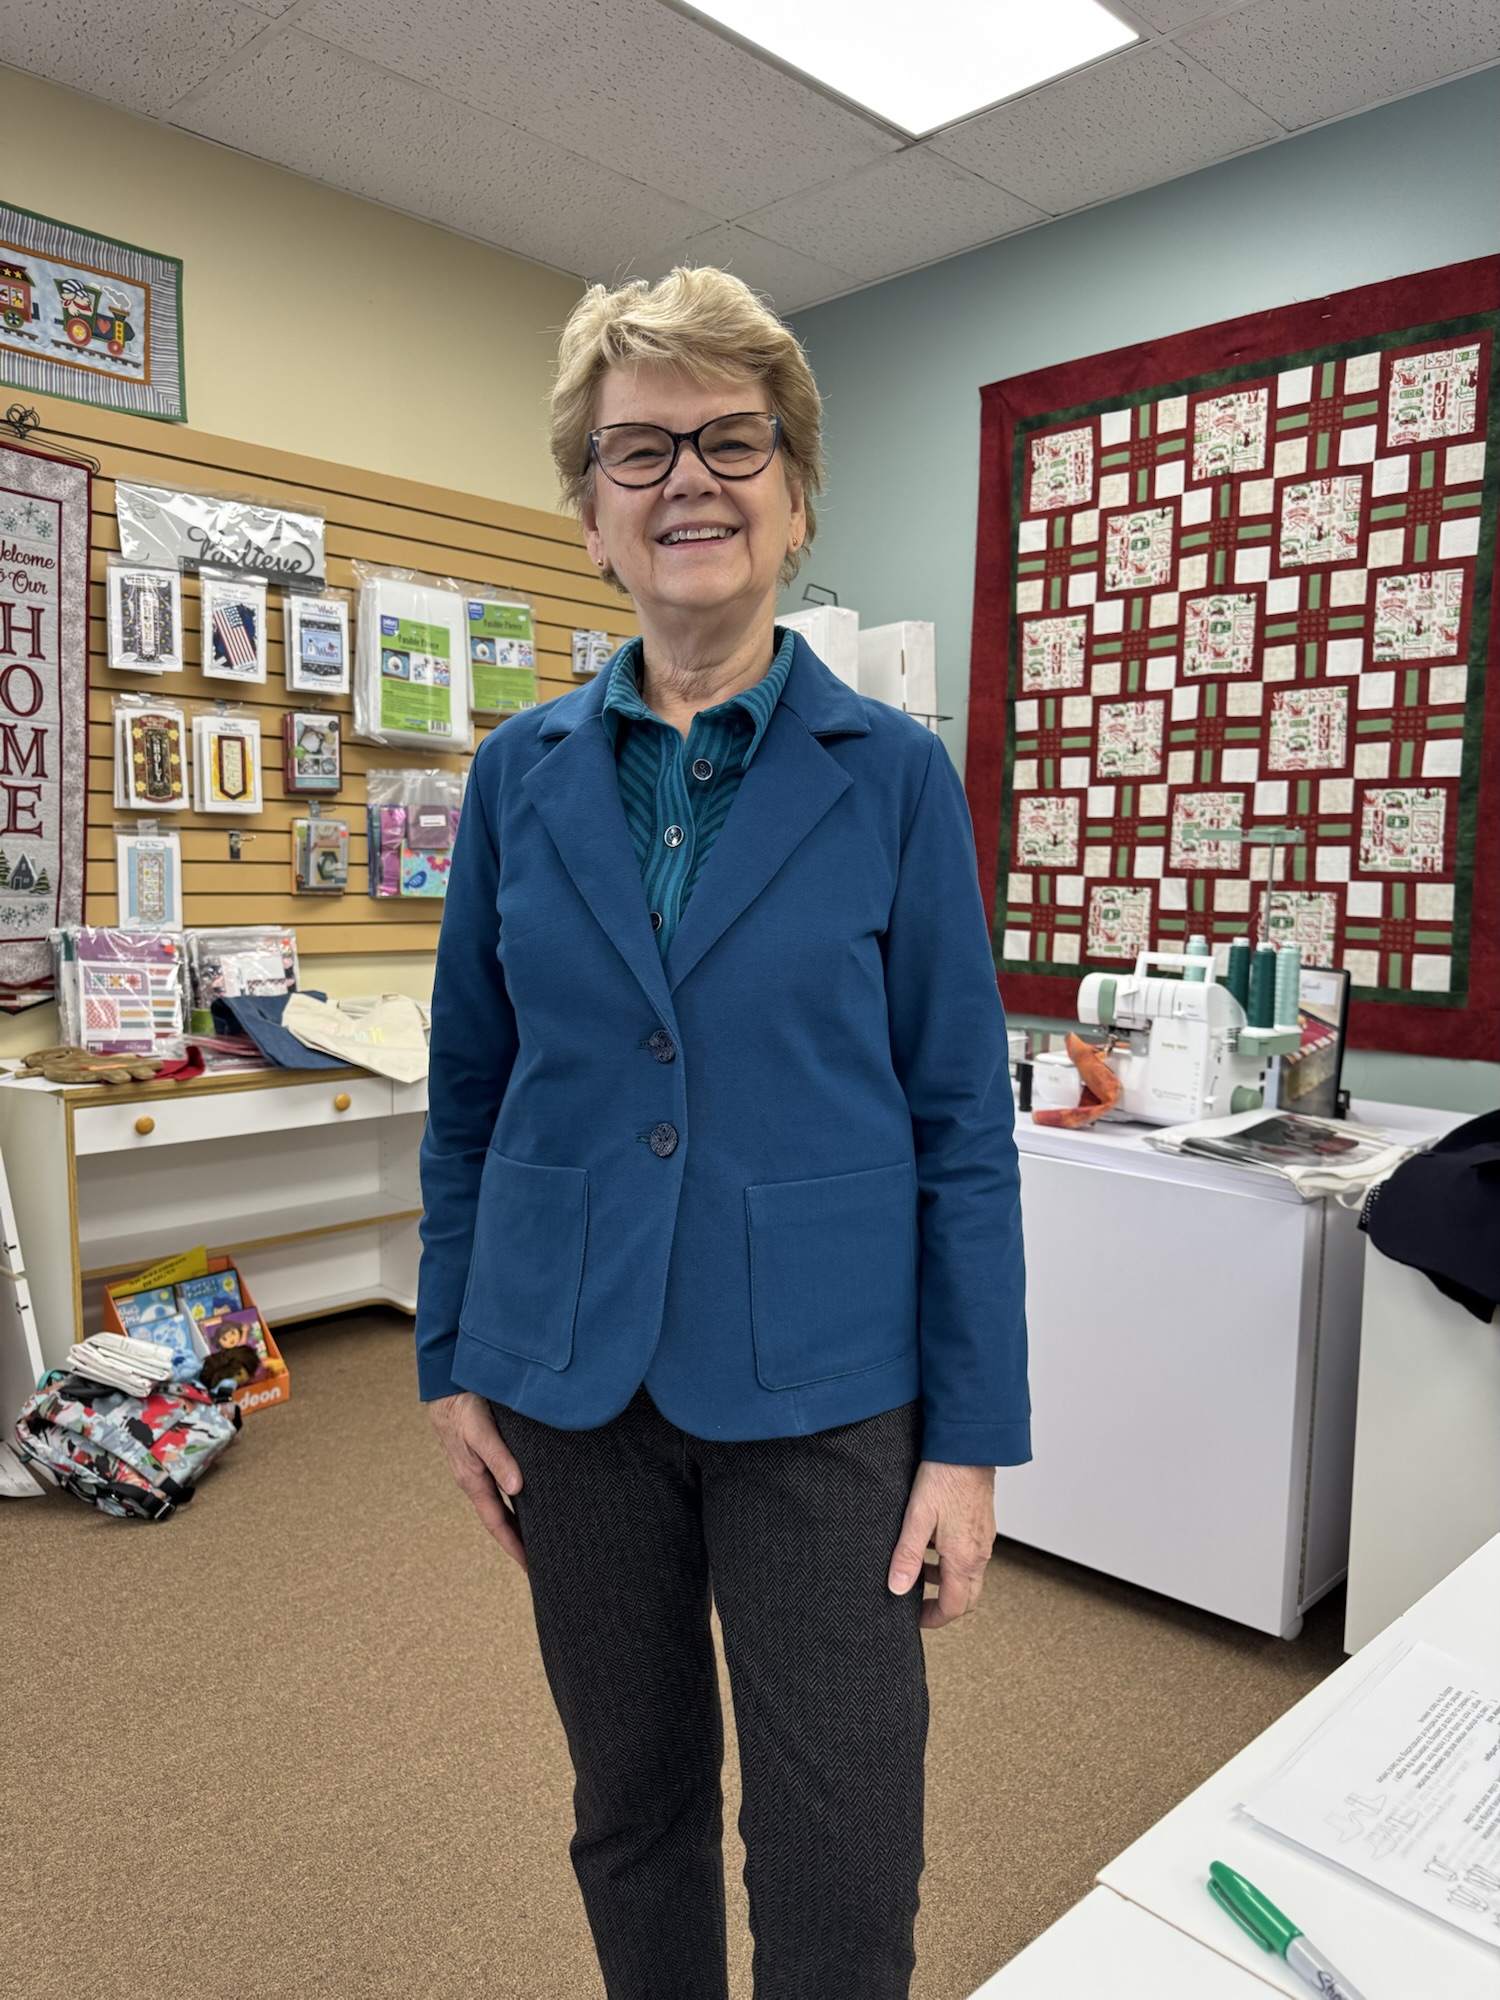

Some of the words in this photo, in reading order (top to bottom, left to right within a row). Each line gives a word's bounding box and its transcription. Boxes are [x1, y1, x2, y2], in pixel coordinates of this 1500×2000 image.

[1434, 382, 1447, 419] JOY
[8, 570, 48, 595] Our
[1311, 1970, 1346, 2000] Sha
